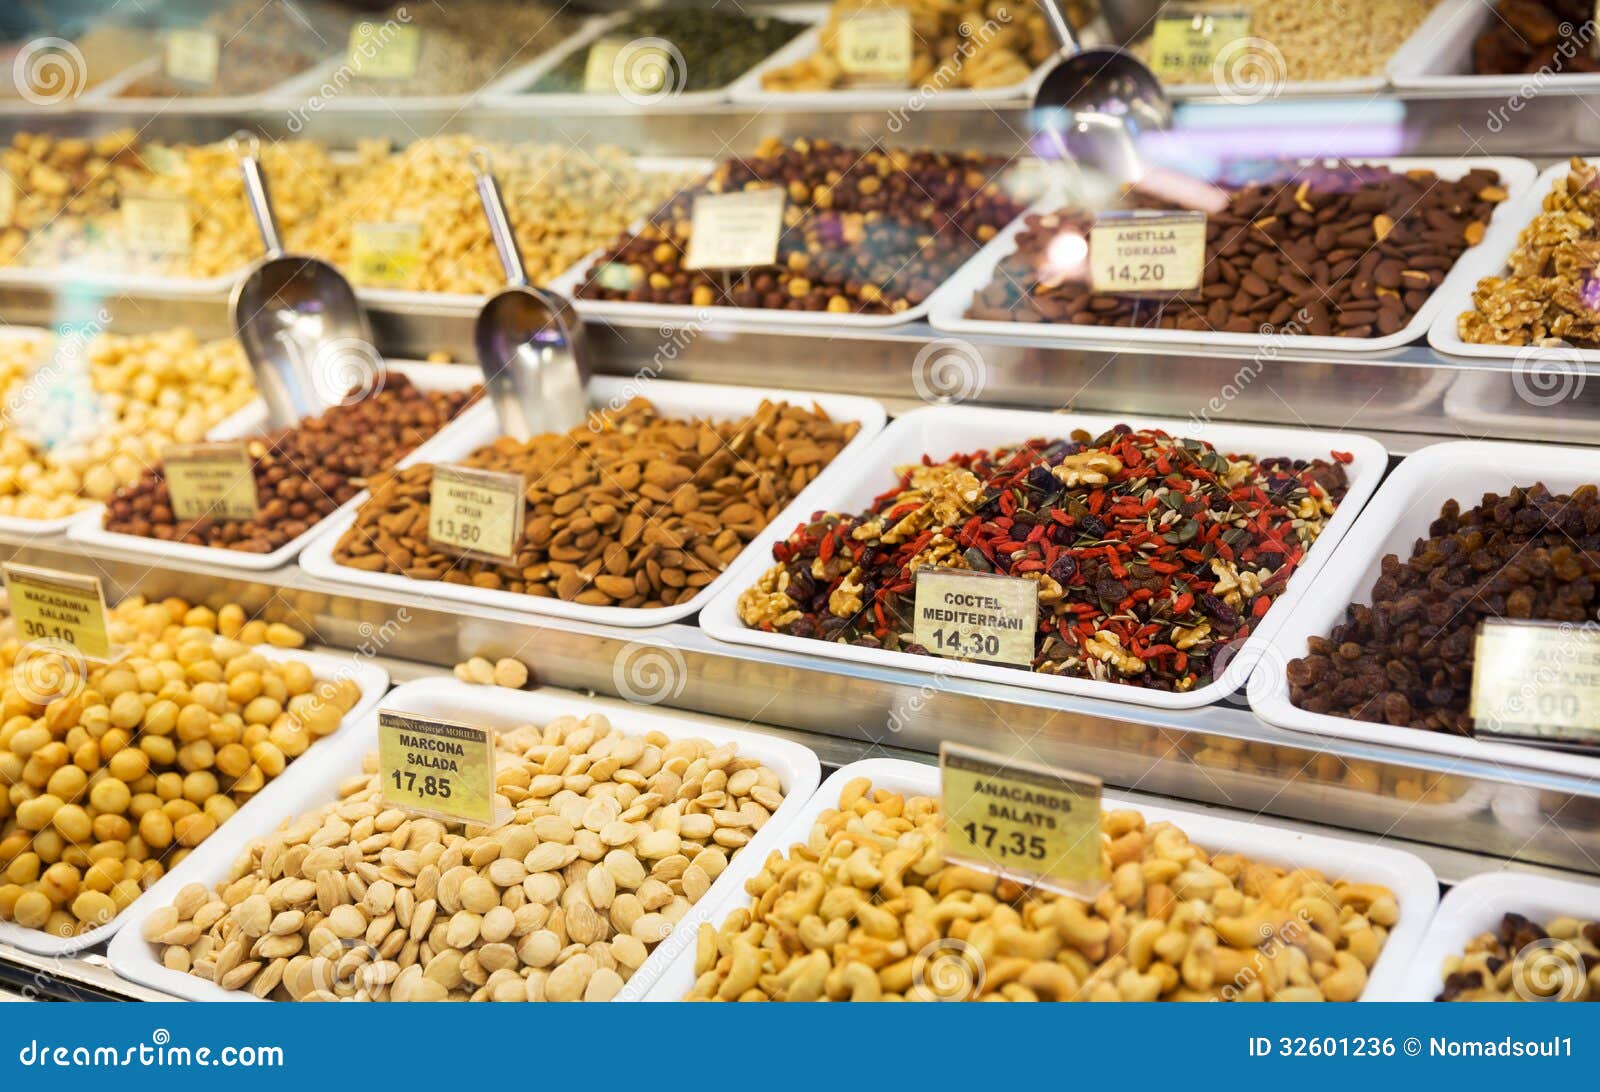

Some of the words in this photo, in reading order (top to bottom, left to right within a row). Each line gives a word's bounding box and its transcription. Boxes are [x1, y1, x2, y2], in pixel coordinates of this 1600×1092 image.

[1117, 230, 1176, 241] AMETLLA
[1107, 264, 1165, 284] 14,20
[436, 519, 480, 543] 13,80
[944, 592, 1002, 610] COCTEL
[39, 607, 81, 625] SALADA
[923, 608, 1024, 630] MEDITERRANI
[932, 628, 1000, 656] 14,30
[399, 734, 464, 756] MARCONA
[407, 752, 458, 772] SALADA
[392, 769, 452, 799] 17,85
[974, 780, 1072, 813] ANACARDS
[988, 803, 1057, 830] SALATS
[963, 821, 1047, 860] 17,35
